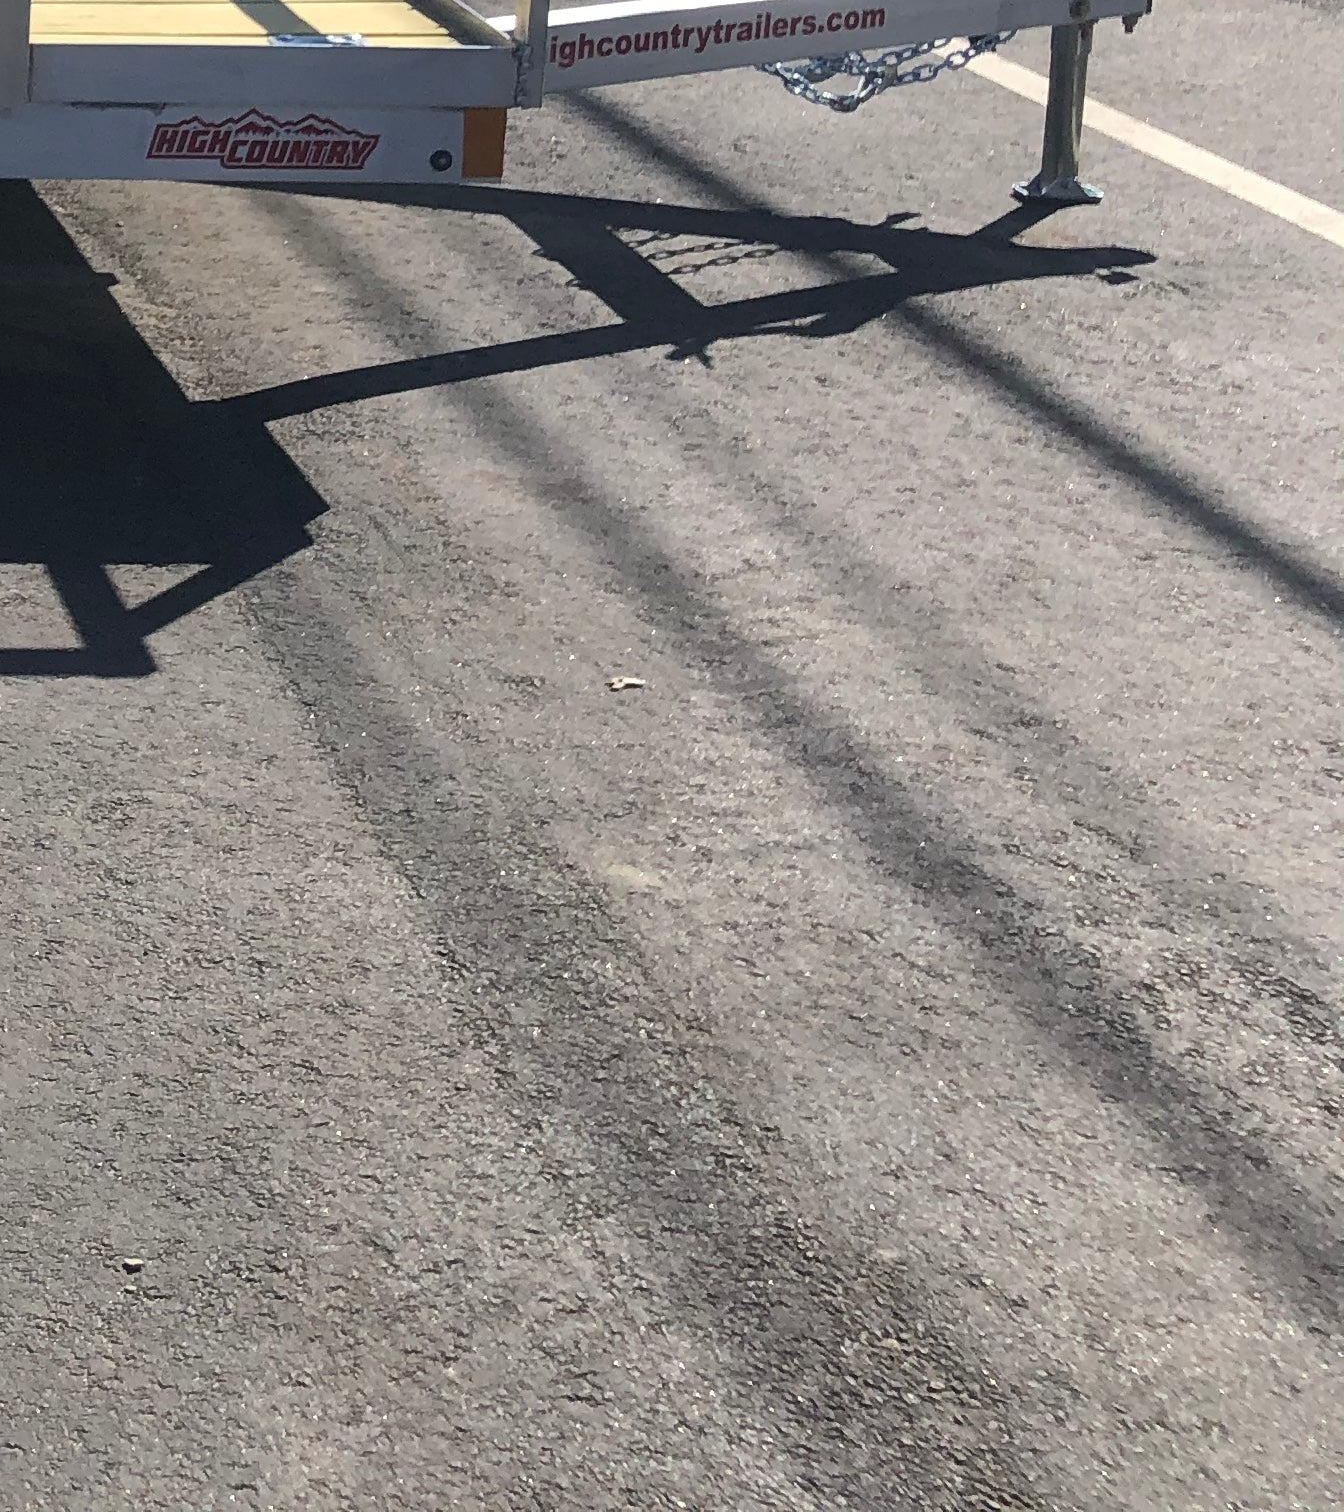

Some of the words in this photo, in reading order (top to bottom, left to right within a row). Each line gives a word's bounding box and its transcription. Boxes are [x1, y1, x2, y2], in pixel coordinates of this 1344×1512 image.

[549, 7, 886, 68] ighcountrytrailers.com
[154, 128, 233, 154] HIGH
[226, 139, 372, 165] COUNTRY
